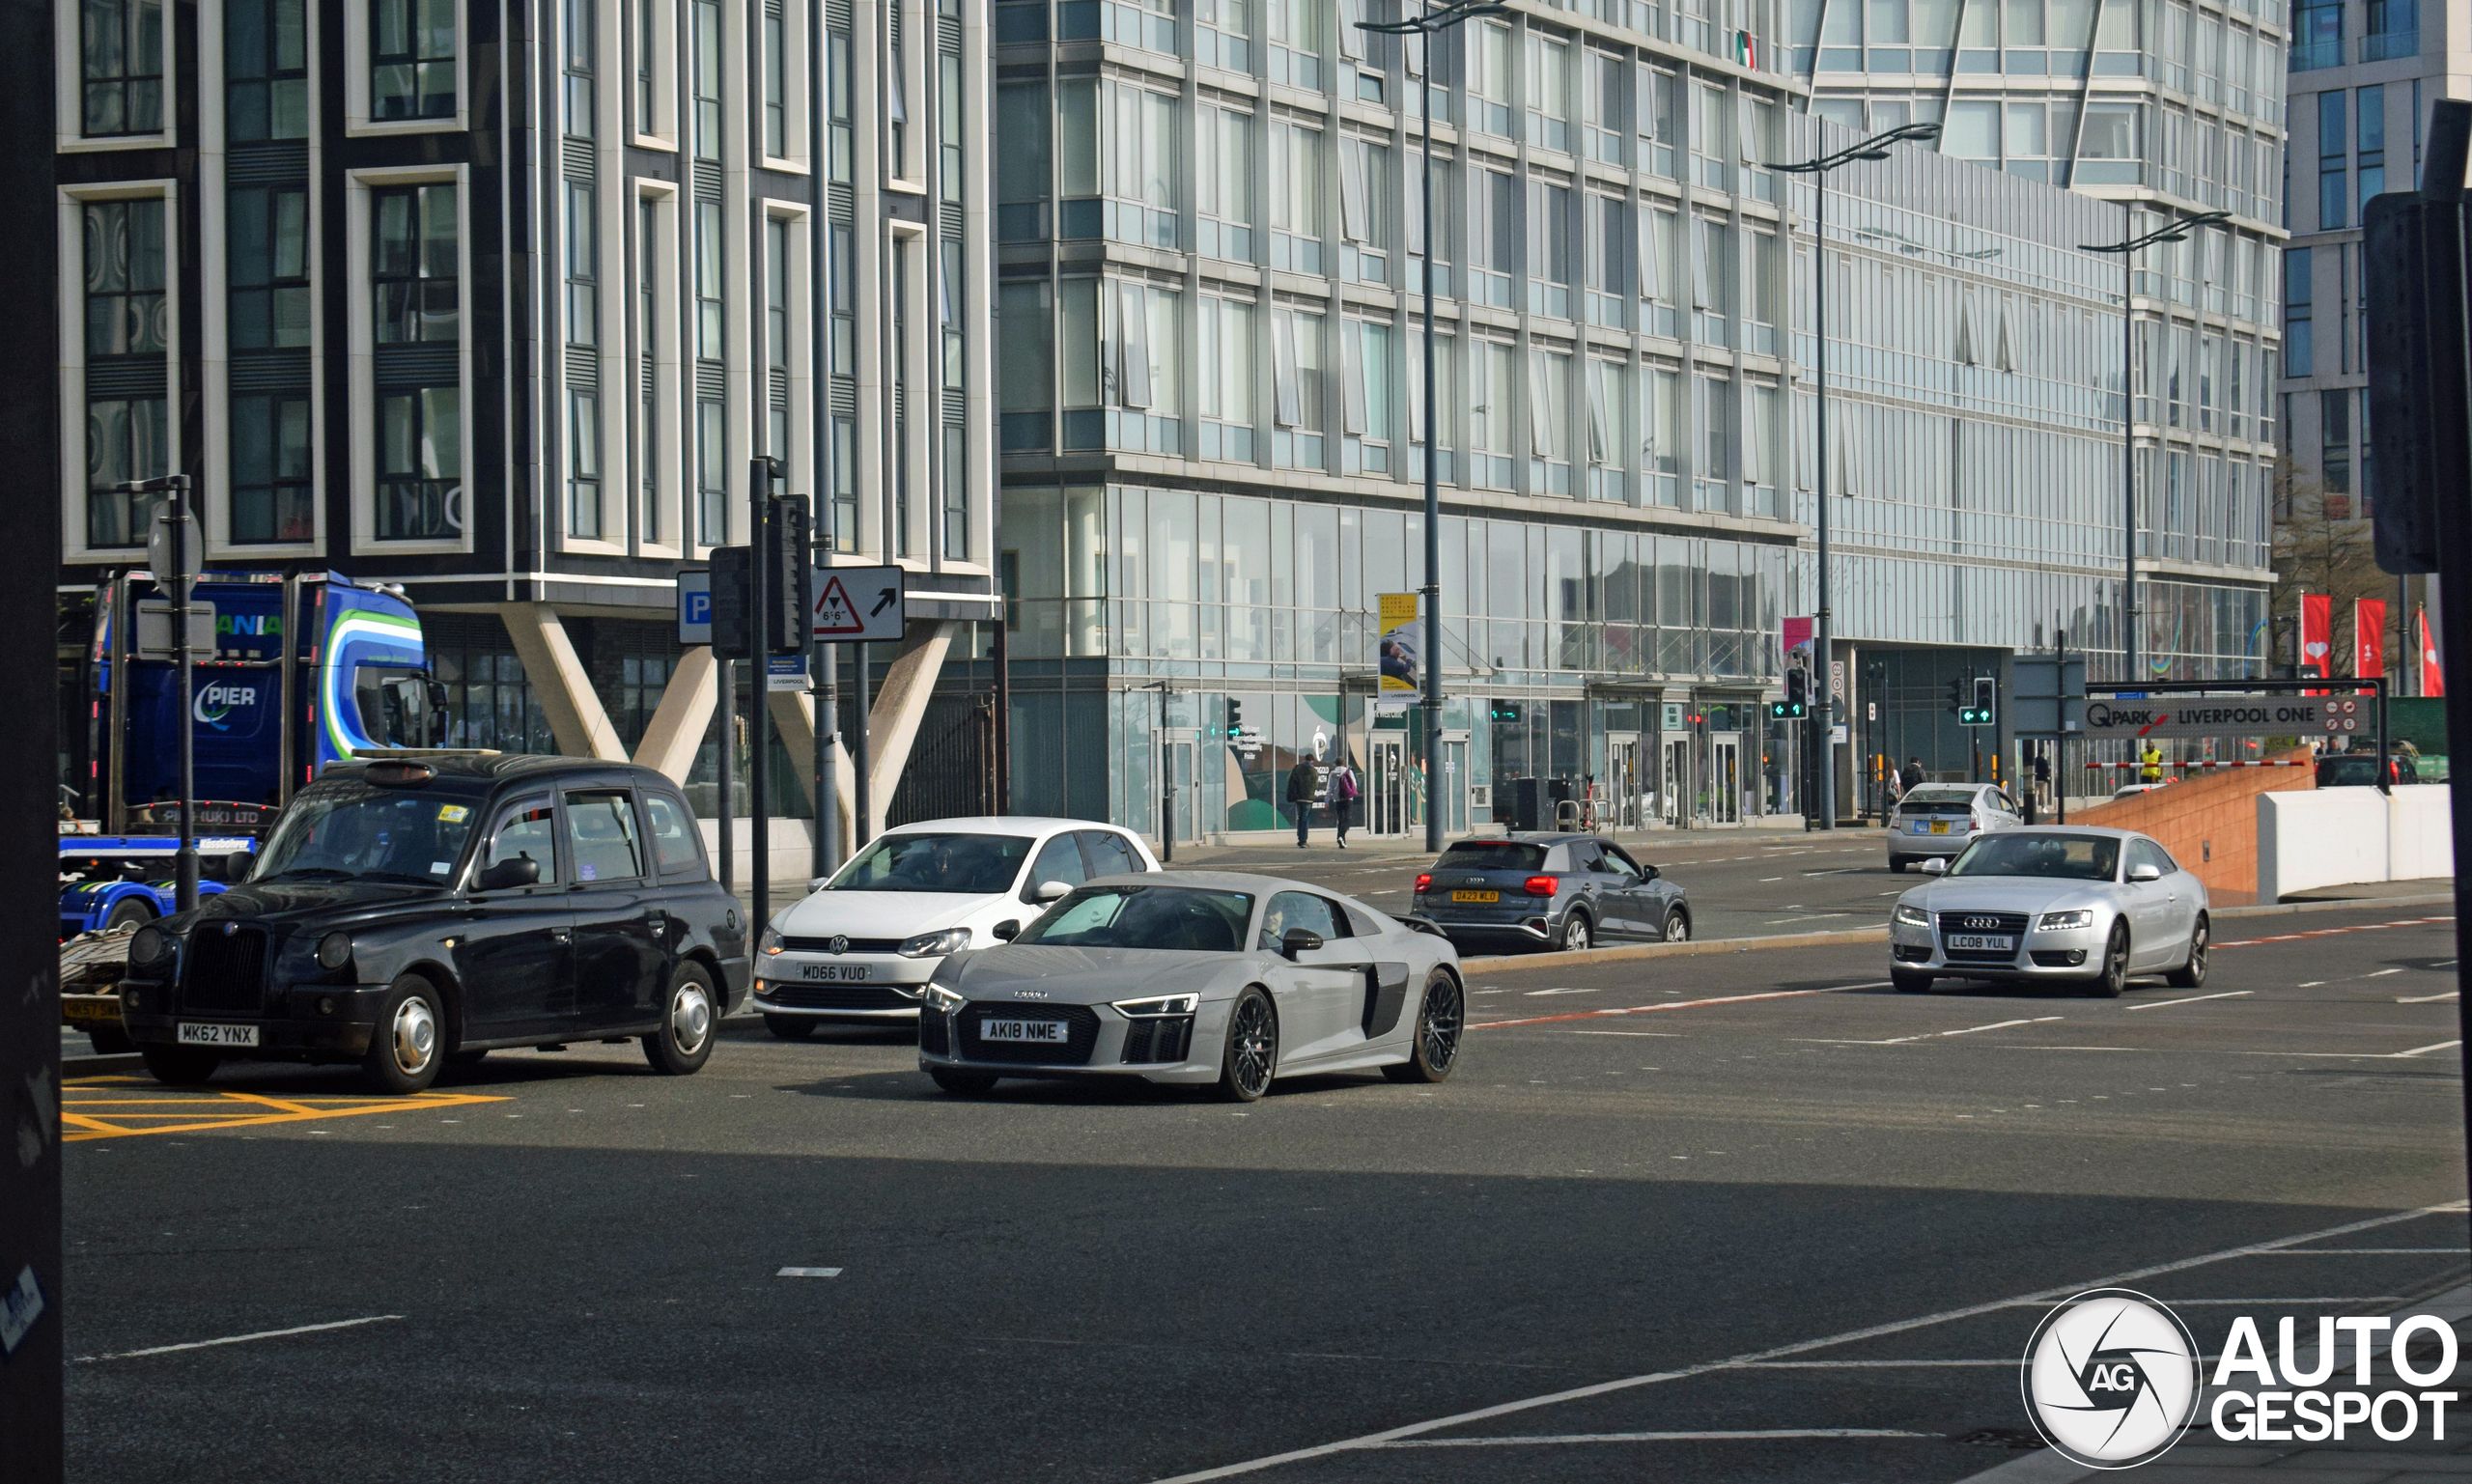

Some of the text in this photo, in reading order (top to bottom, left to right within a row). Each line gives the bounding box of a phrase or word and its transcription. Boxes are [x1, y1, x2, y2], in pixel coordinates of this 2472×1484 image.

[692, 595, 711, 621] P
[215, 615, 282, 635] ANIA
[207, 686, 256, 706] PIER
[2177, 708, 2270, 724] LIVERPOOL
[2276, 707, 2316, 722] ONE
[200, 810, 230, 823] (UK)
[235, 811, 259, 824] LTD
[1455, 891, 1478, 900] DA23
[1952, 937, 2008, 949] LC08 YUL
[802, 966, 865, 980] MD66 VUO
[183, 1024, 252, 1044] MK62 YNX
[990, 1022, 1057, 1040] AK18 NME
